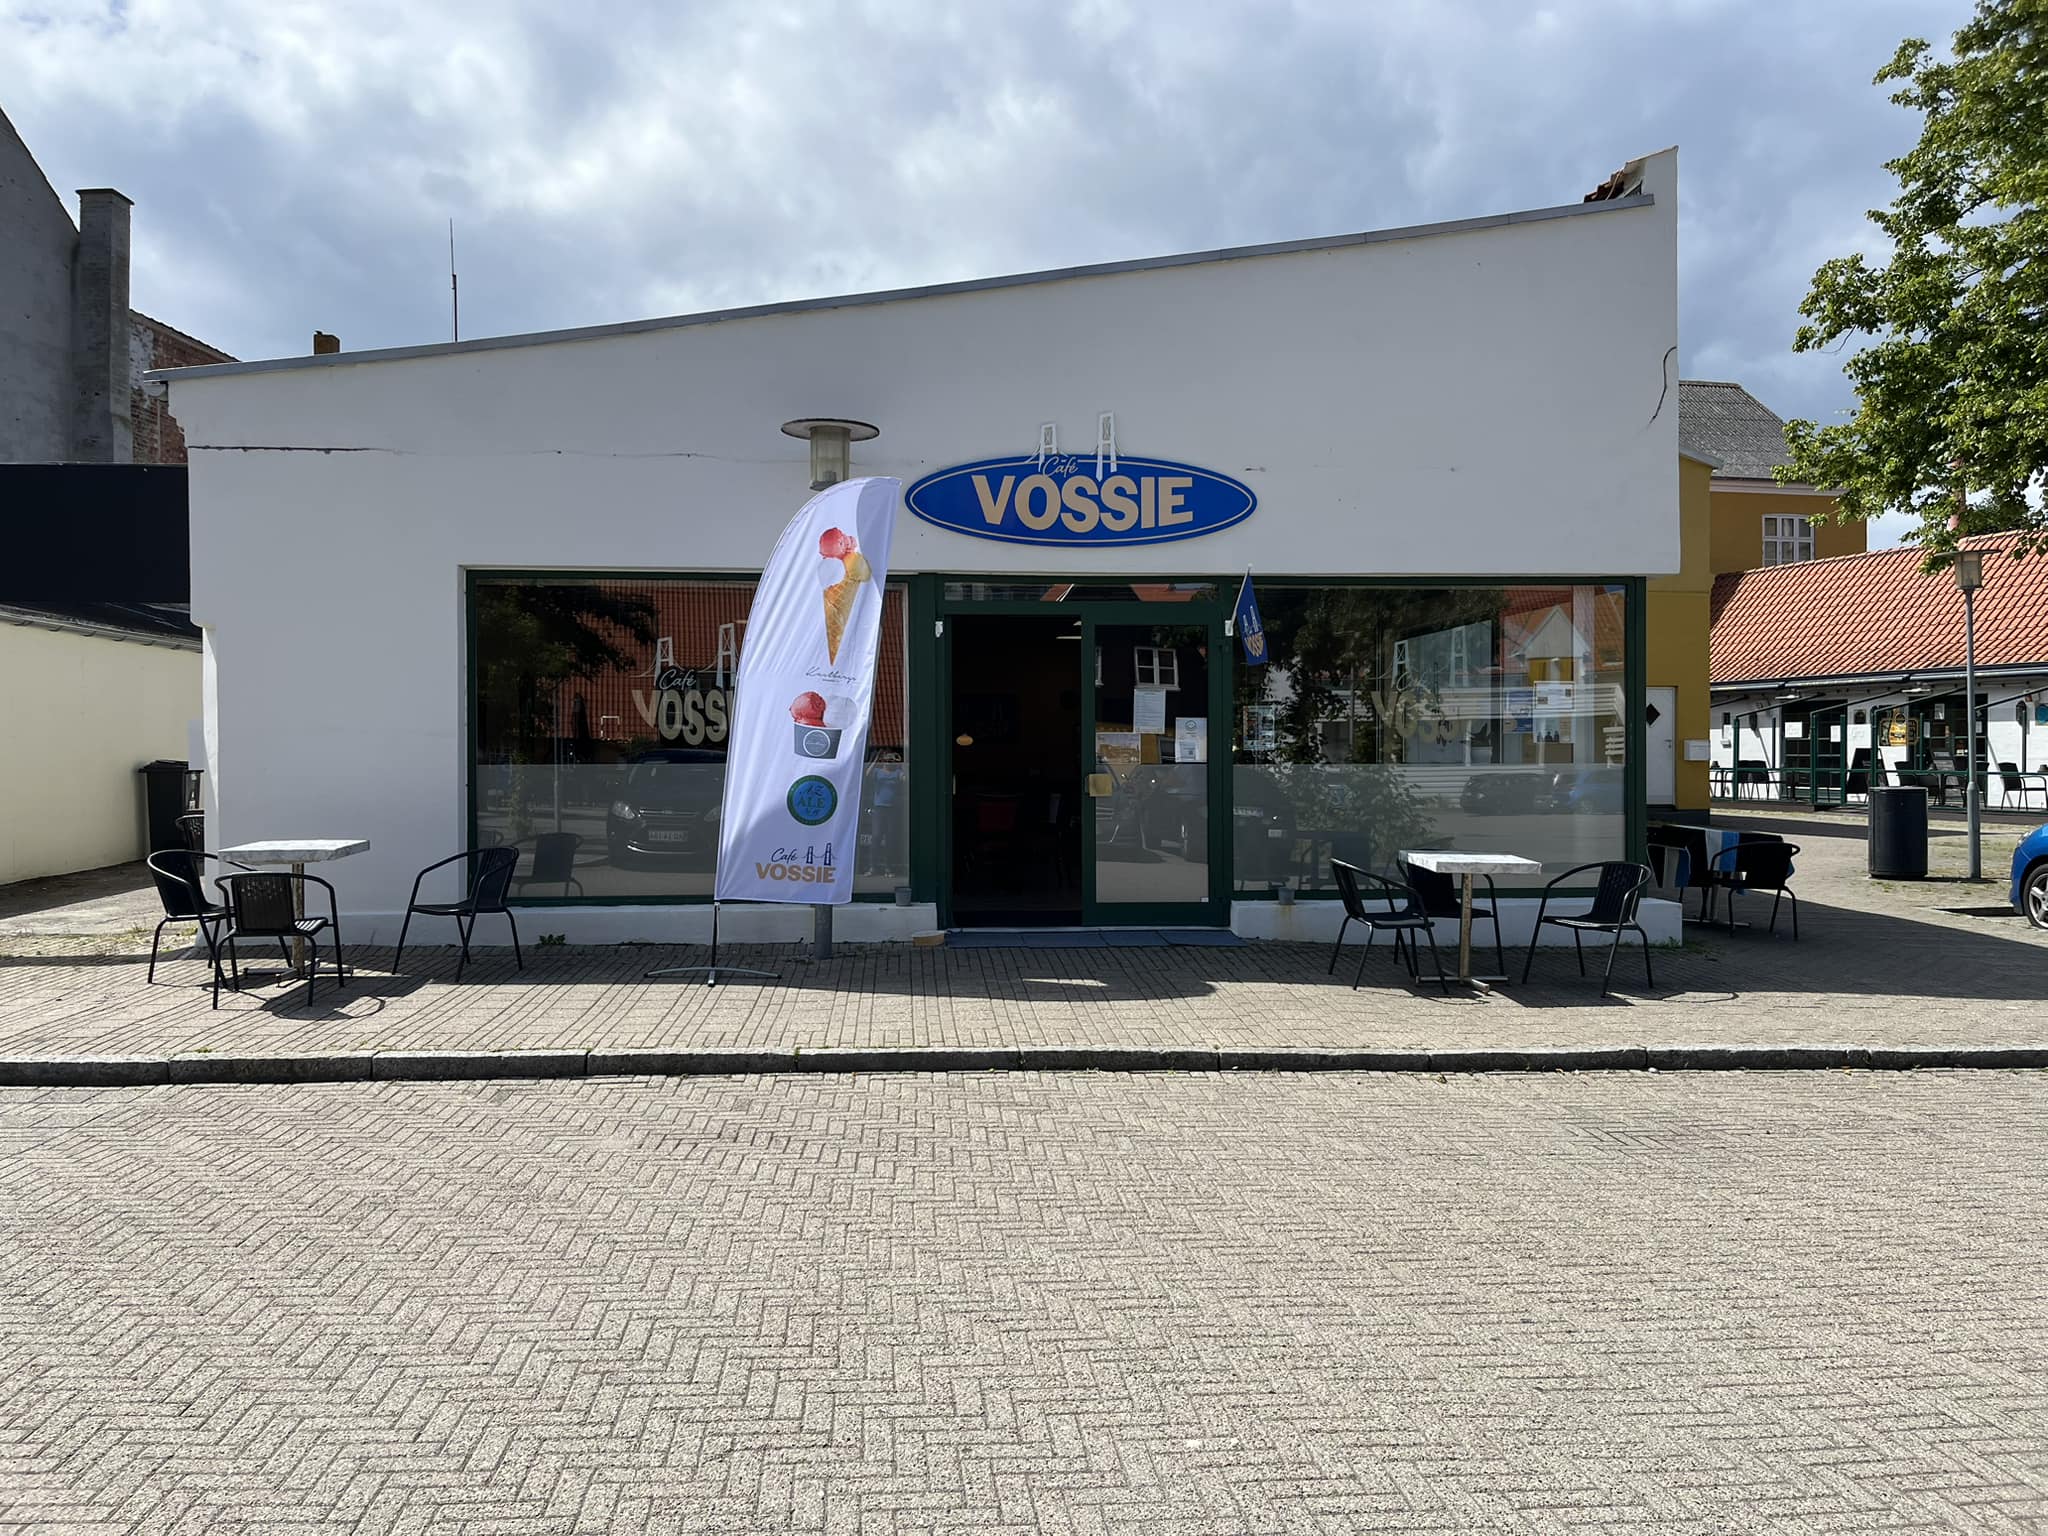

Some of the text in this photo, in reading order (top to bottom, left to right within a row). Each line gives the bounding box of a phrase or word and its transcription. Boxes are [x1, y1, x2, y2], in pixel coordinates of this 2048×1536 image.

[1042, 456, 1079, 479] Café
[971, 474, 1194, 533] VOSSIE
[658, 668, 697, 690] Café
[771, 847, 799, 864] Café
[755, 862, 837, 884] VOSSIE
